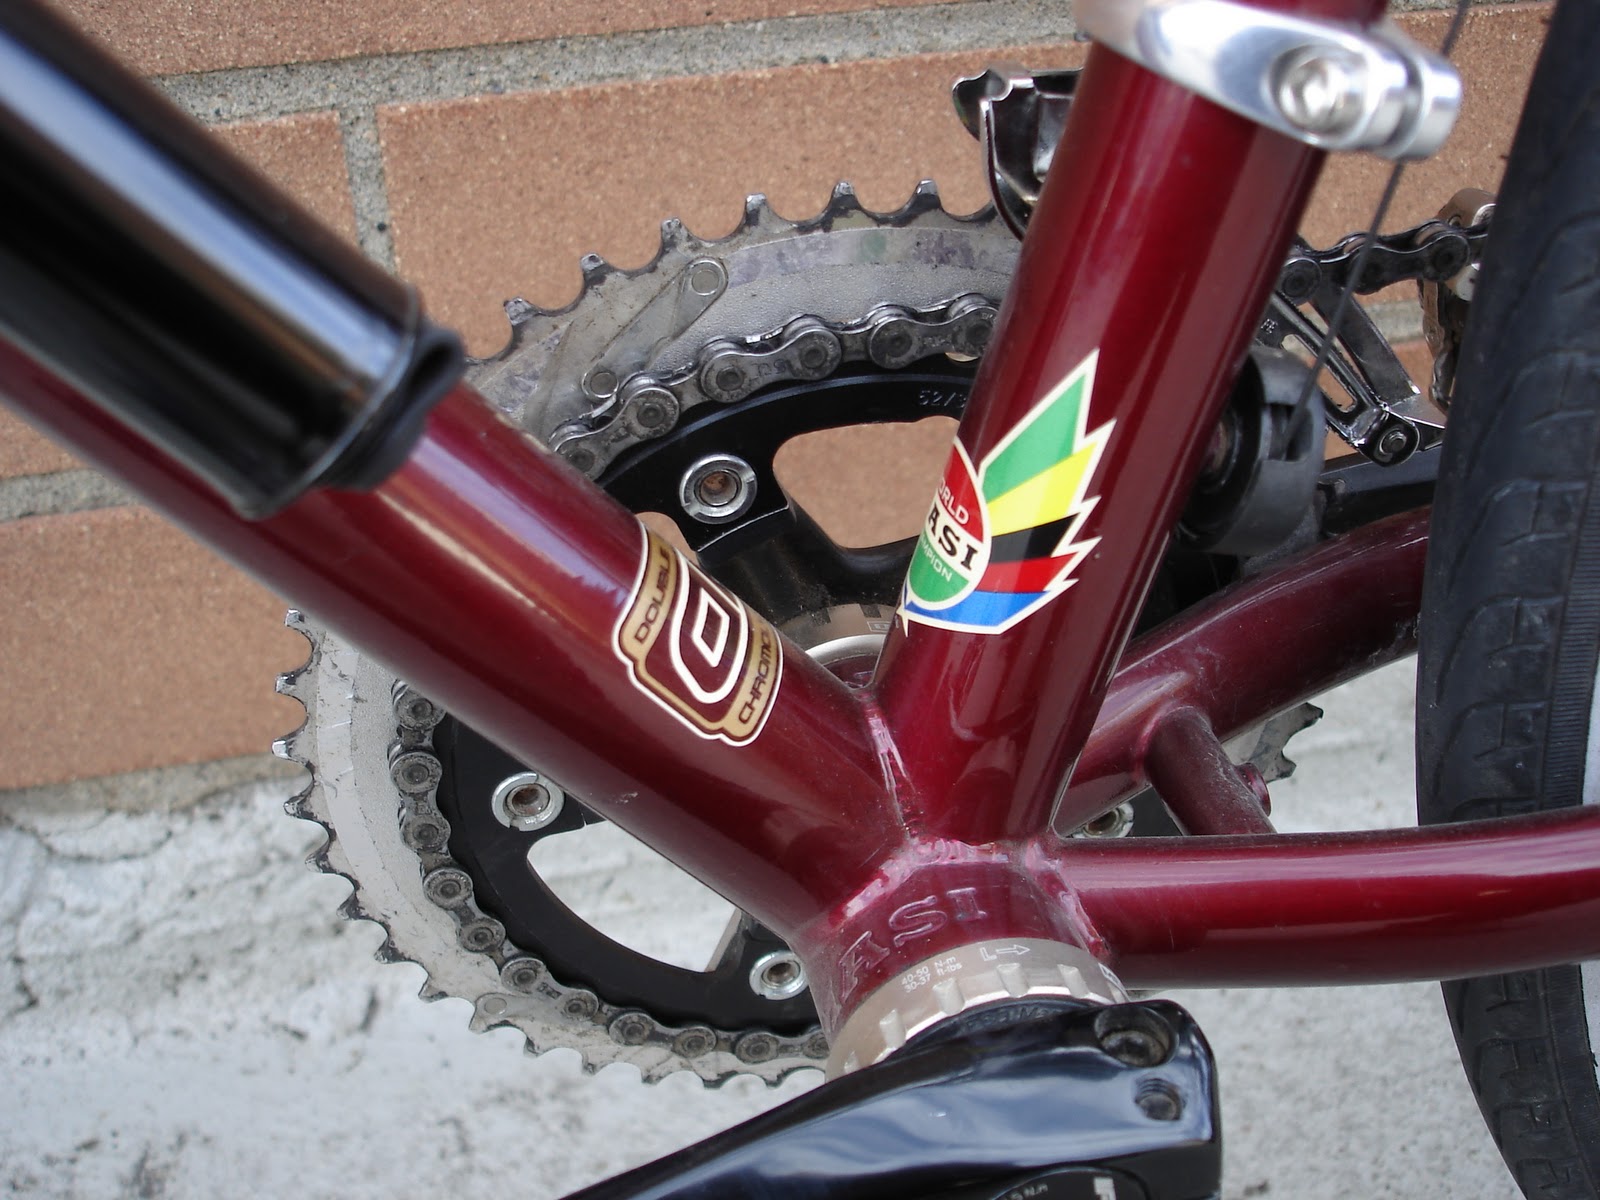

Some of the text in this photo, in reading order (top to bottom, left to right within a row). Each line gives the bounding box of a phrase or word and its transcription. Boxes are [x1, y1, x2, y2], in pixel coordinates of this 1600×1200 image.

[919, 389, 968, 408] 52/3
[938, 478, 970, 525] ORLD
[928, 501, 979, 571] ASI
[920, 538, 953, 582] MPION
[902, 966, 929, 985] 40-50
[904, 973, 931, 993] 30-37
